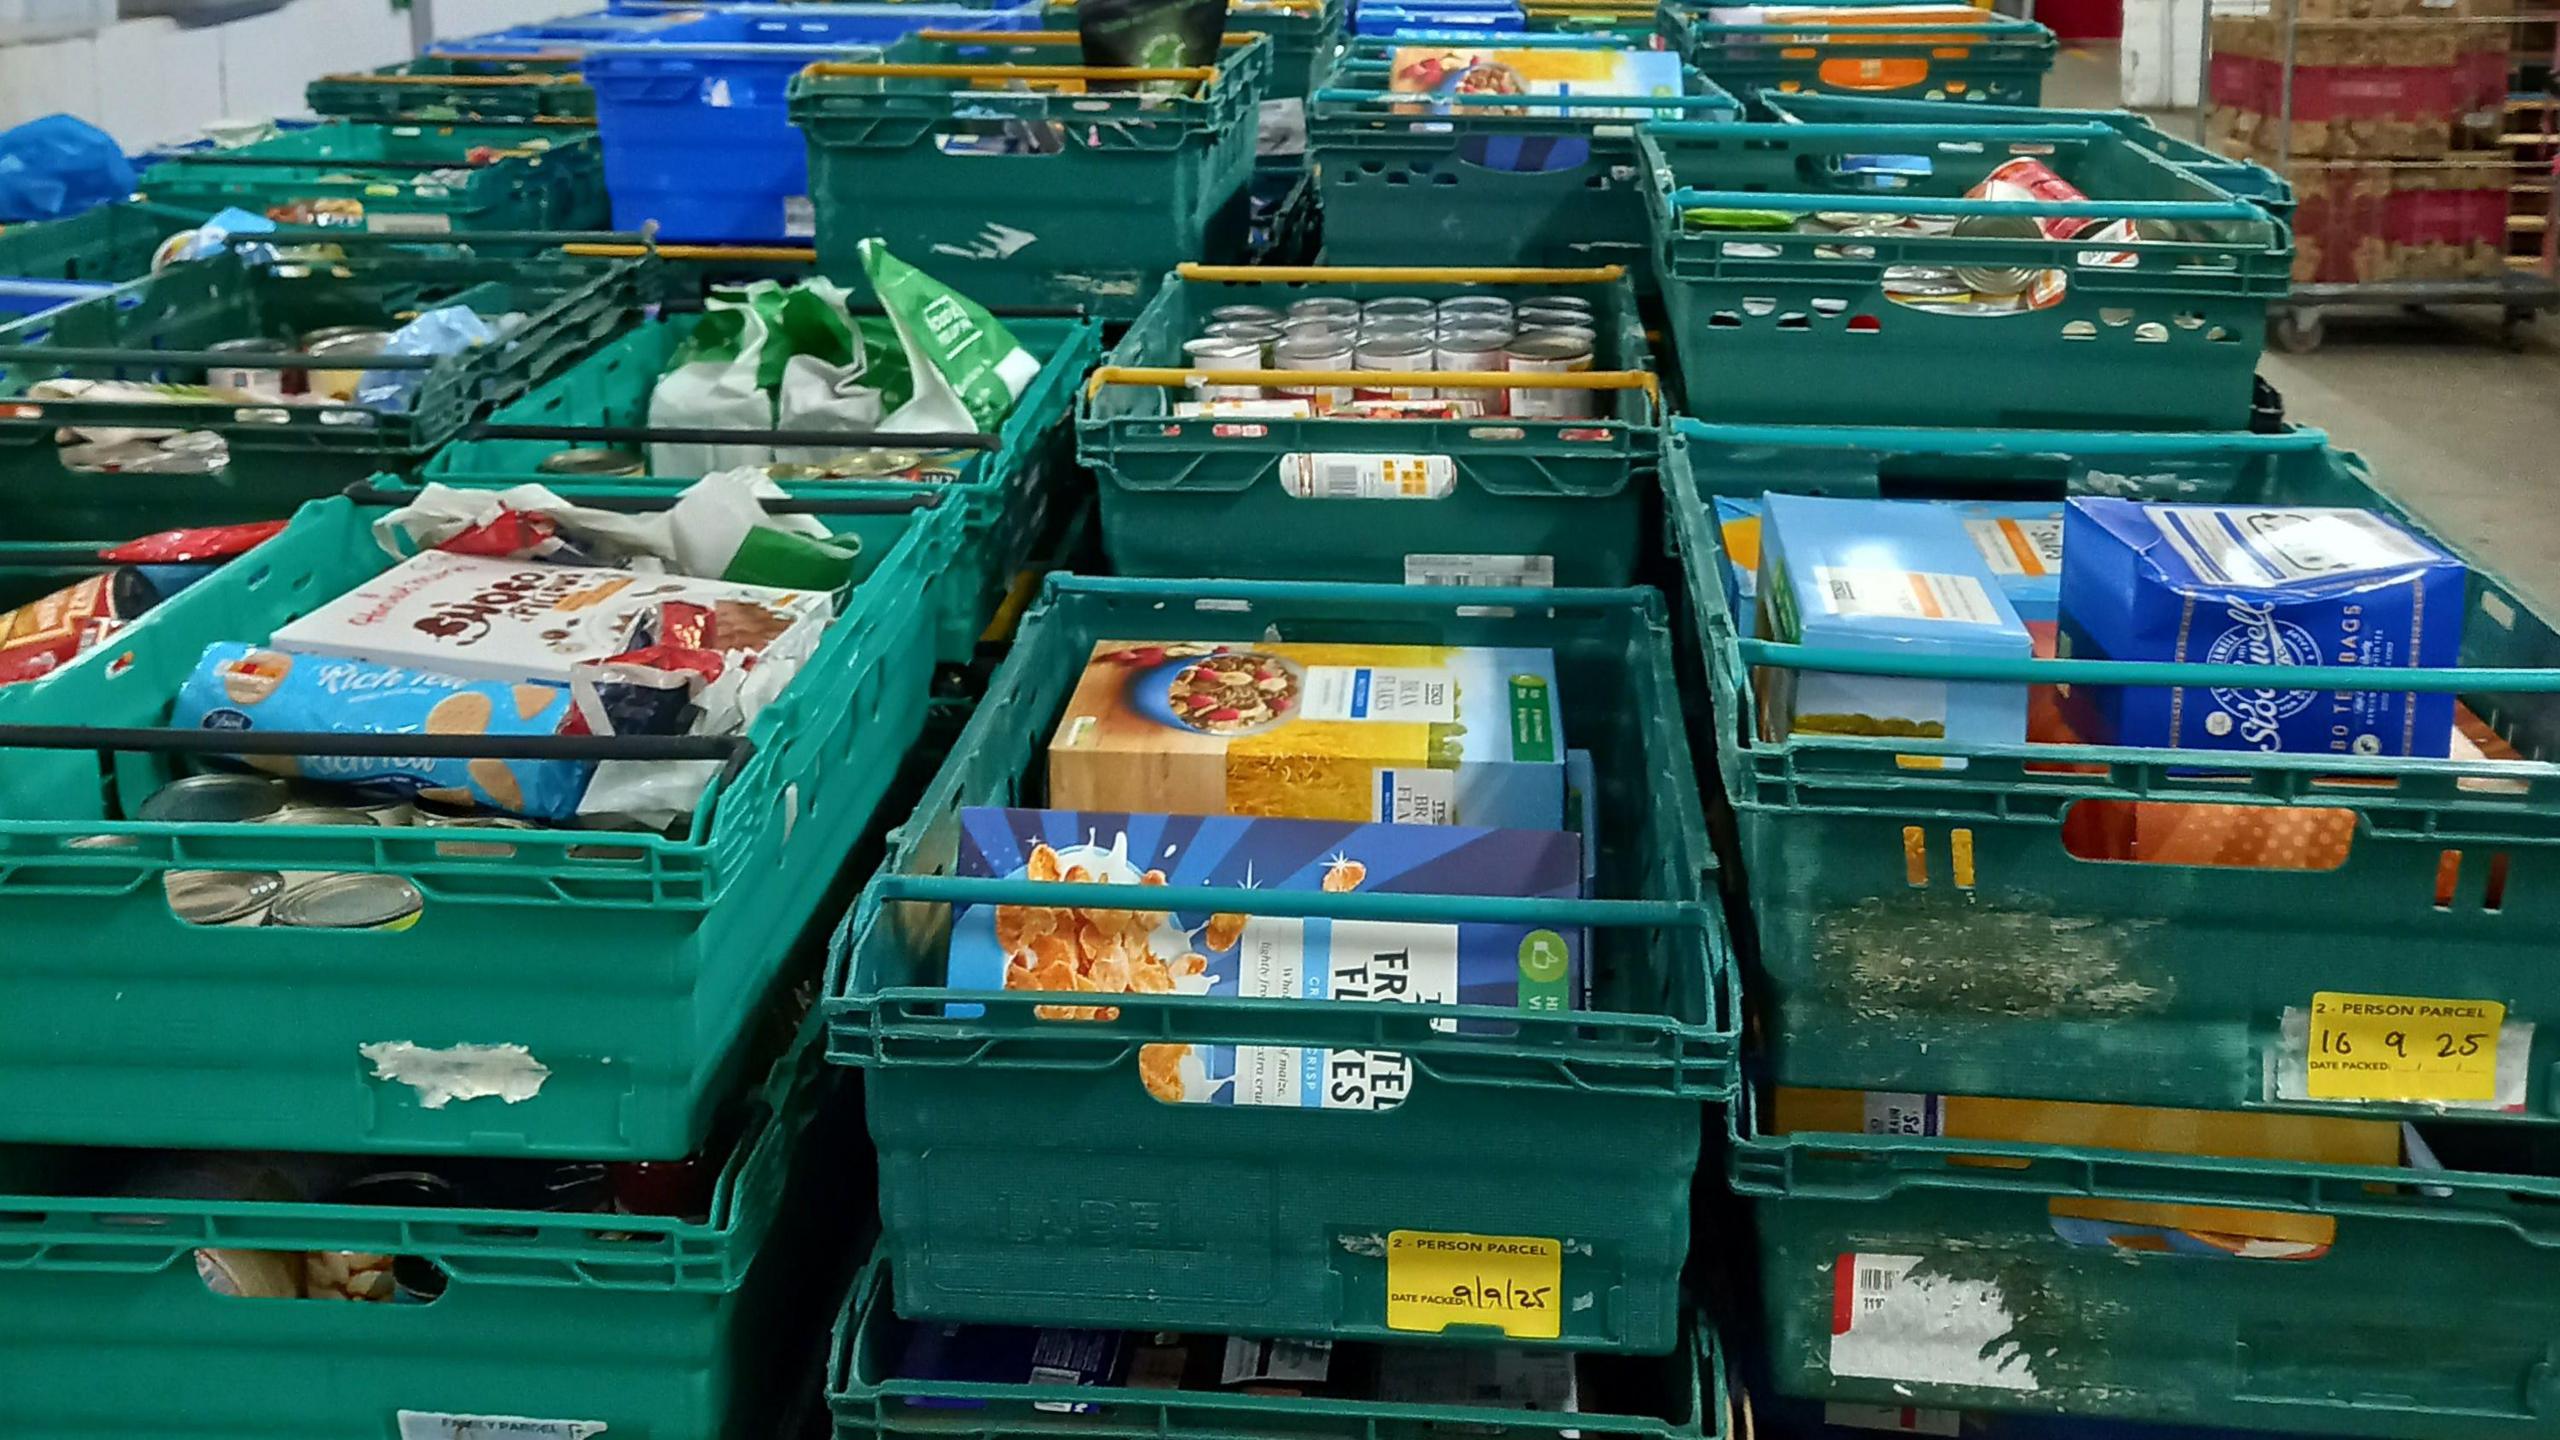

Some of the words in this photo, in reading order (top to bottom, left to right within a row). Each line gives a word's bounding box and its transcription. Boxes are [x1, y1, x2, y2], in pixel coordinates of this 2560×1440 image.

[2337, 604, 2364, 664] BAGS
[317, 664, 399, 695] Rich
[2225, 594, 2283, 752] Stocwell
[2315, 1003, 2326, 1015] 2
[2342, 1003, 2415, 1017] PERSON
[2420, 1005, 2487, 1019] PARCEL
[1370, 946, 1411, 1111] FRTED
[2384, 1030, 2407, 1059] 9
[2436, 1032, 2489, 1059] 25
[2309, 1061, 2340, 1071] DATE
[1392, 1238, 1403, 1249] 2
[1416, 1239, 1483, 1252] PERSON
[1487, 1243, 1549, 1256] PARCEL
[1391, 1293, 1418, 1304] DATE
[1452, 1276, 1552, 1309] 9/9/25
[499, 1420, 557, 1433] PARCEL
